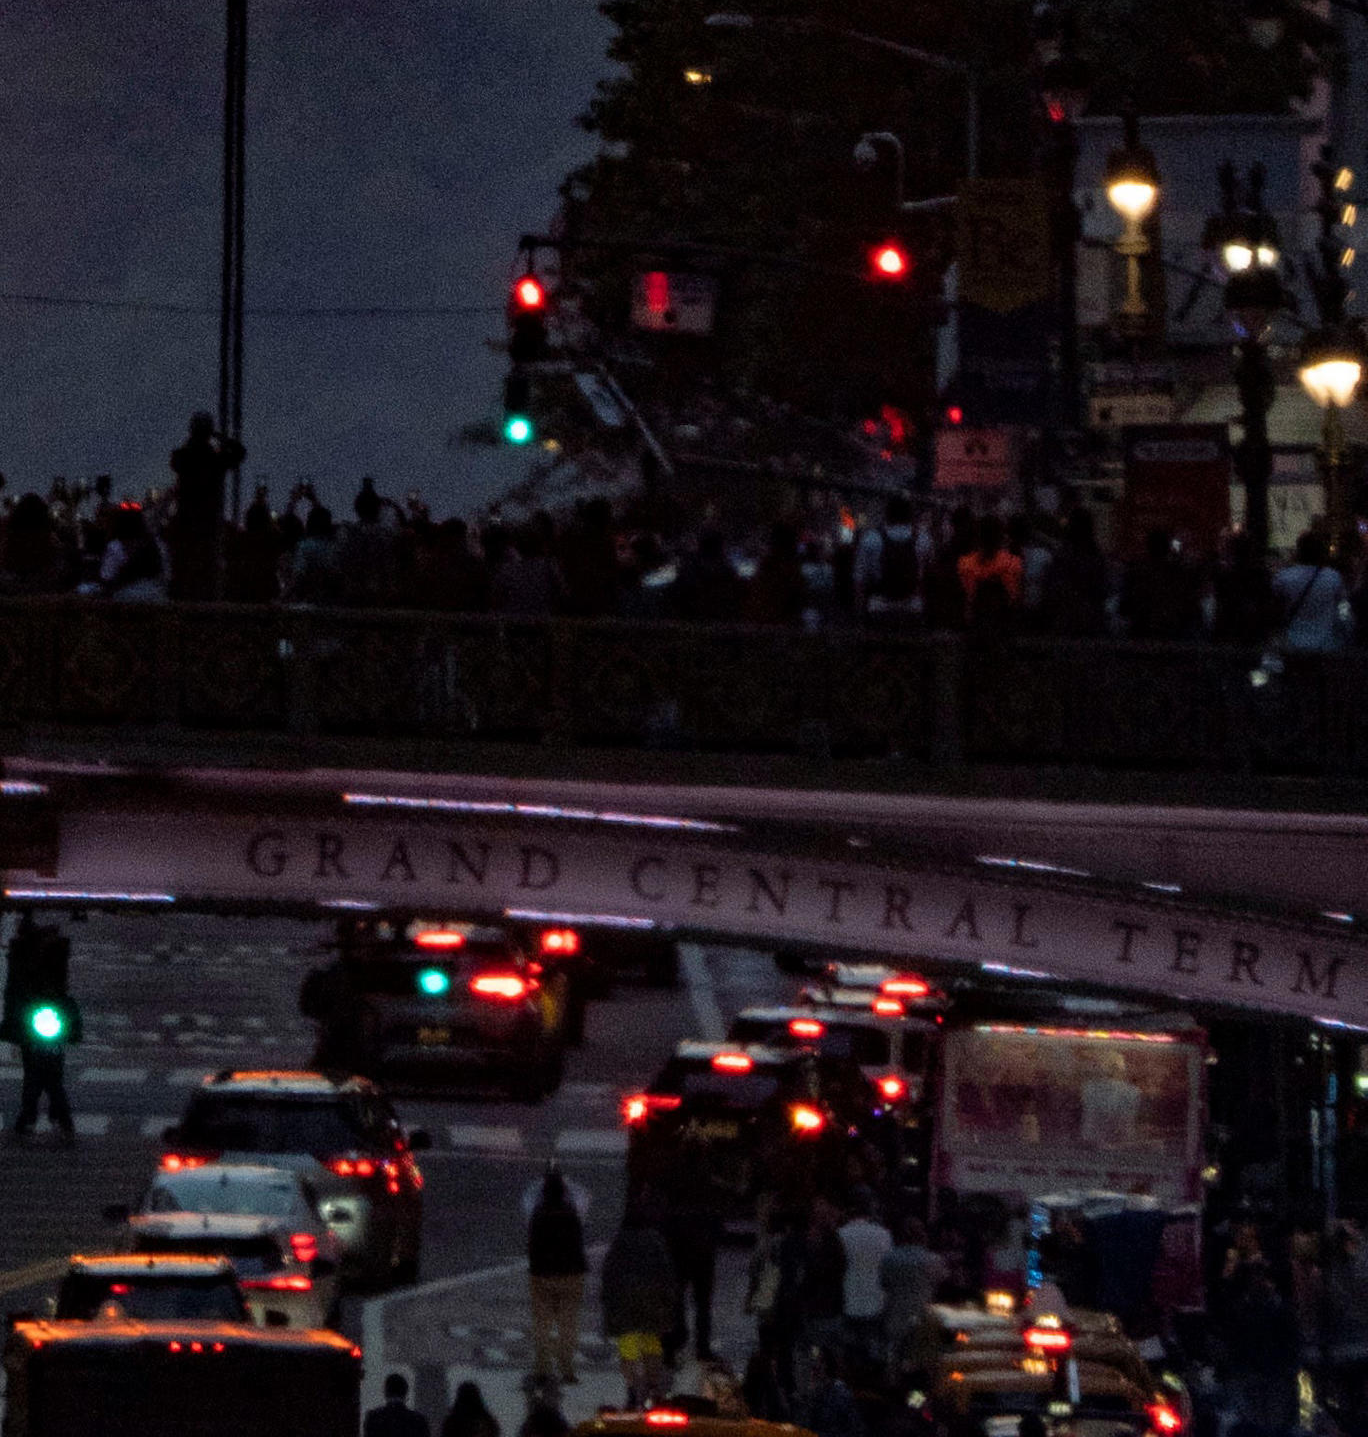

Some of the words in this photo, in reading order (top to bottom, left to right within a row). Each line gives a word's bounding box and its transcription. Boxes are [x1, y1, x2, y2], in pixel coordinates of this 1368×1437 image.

[245, 830, 560, 890] GRAND
[632, 856, 1039, 949] CENTRAL
[1113, 921, 1345, 1000] TERM
